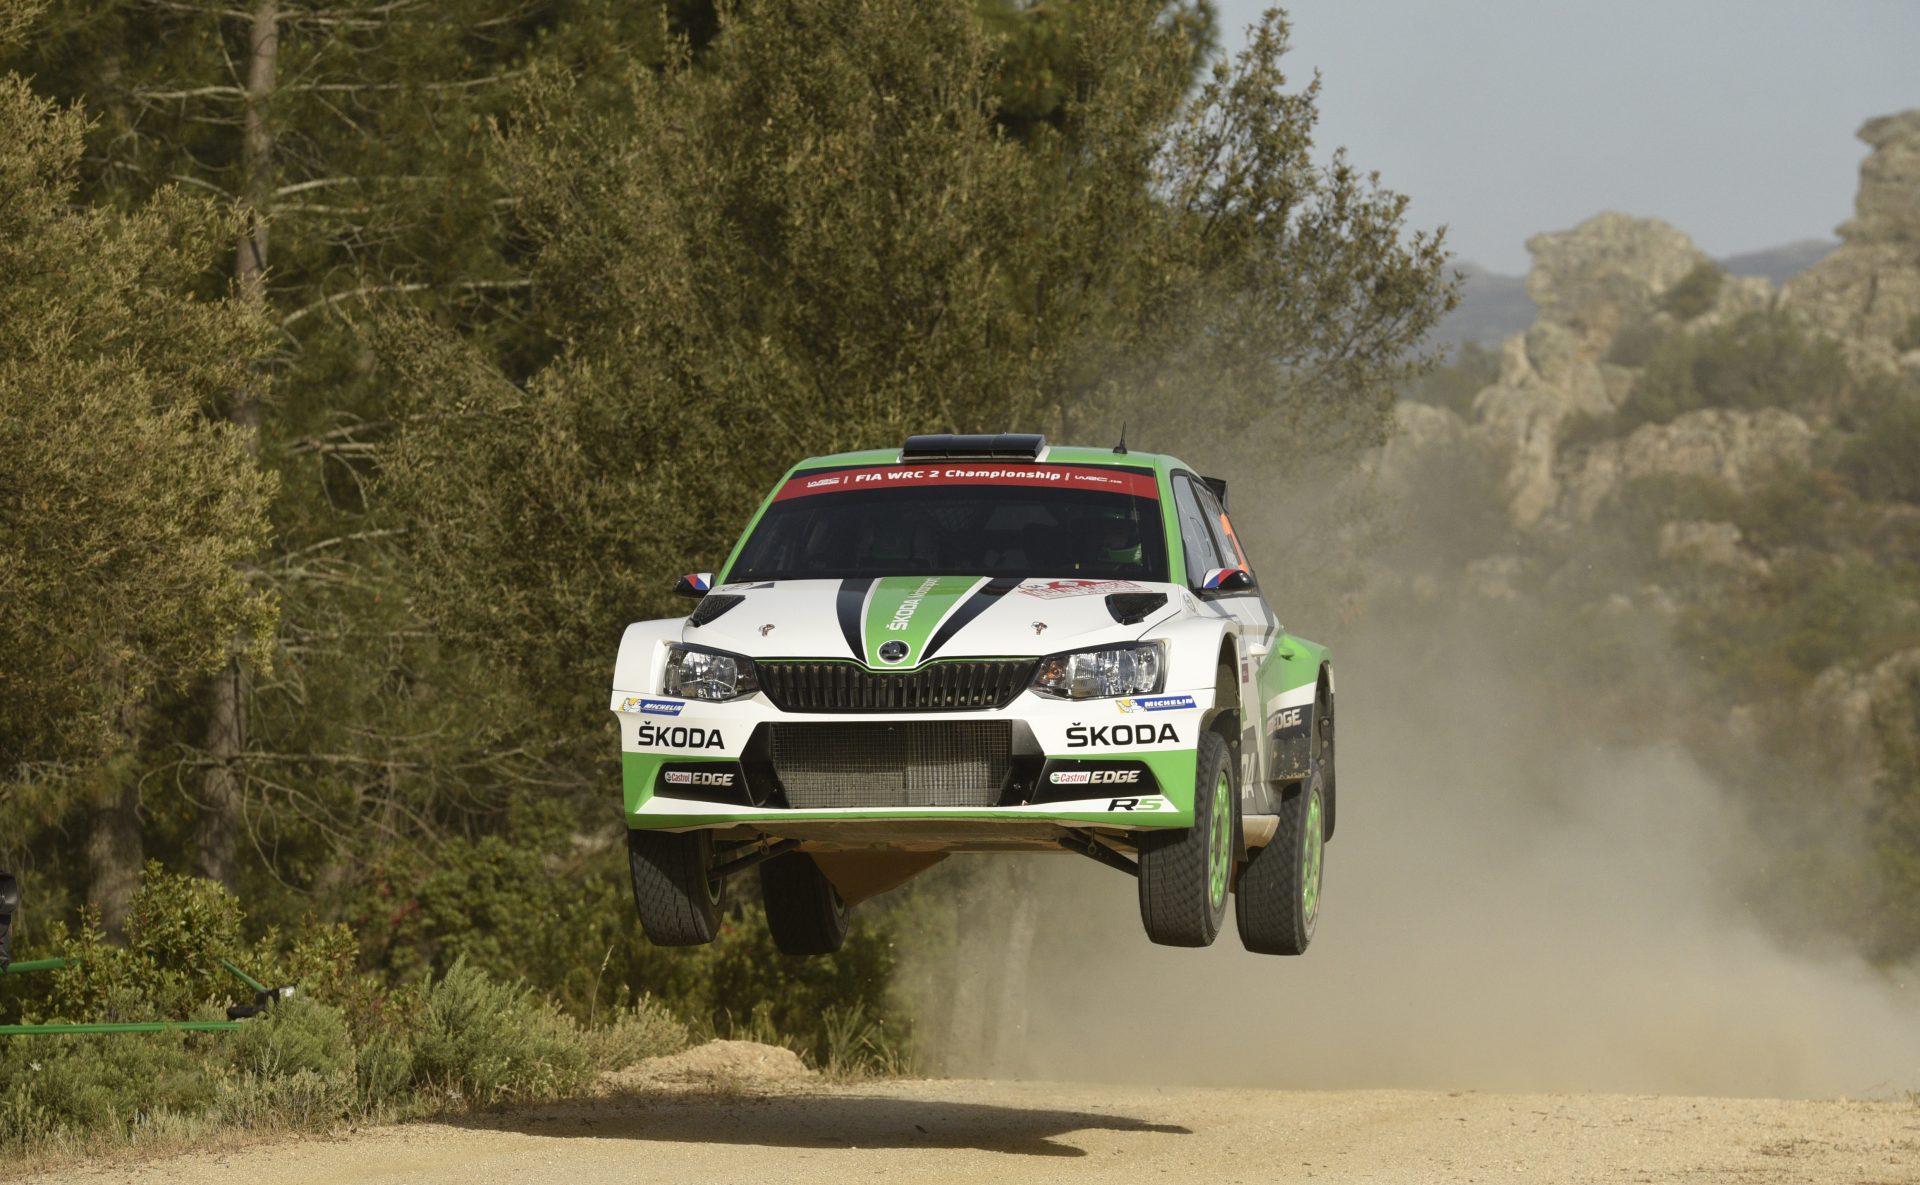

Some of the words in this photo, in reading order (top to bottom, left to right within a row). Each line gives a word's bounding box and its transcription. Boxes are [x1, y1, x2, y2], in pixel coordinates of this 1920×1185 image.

[855, 474, 882, 483] FIA
[887, 470, 925, 480] WRC
[928, 470, 940, 478] 2
[945, 469, 1061, 481] Championship
[885, 594, 923, 631] ŠKODA
[643, 703, 685, 712] MICHELIN
[1144, 698, 1193, 708] MICHELIN
[638, 720, 725, 750] ŠKODA
[1066, 721, 1180, 748] ŠKODA
[671, 773, 690, 783] Castrol
[692, 772, 735, 787] EDGE
[1060, 772, 1088, 784] Castrol
[1089, 769, 1142, 784] EDGE
[1107, 798, 1164, 812] R5
